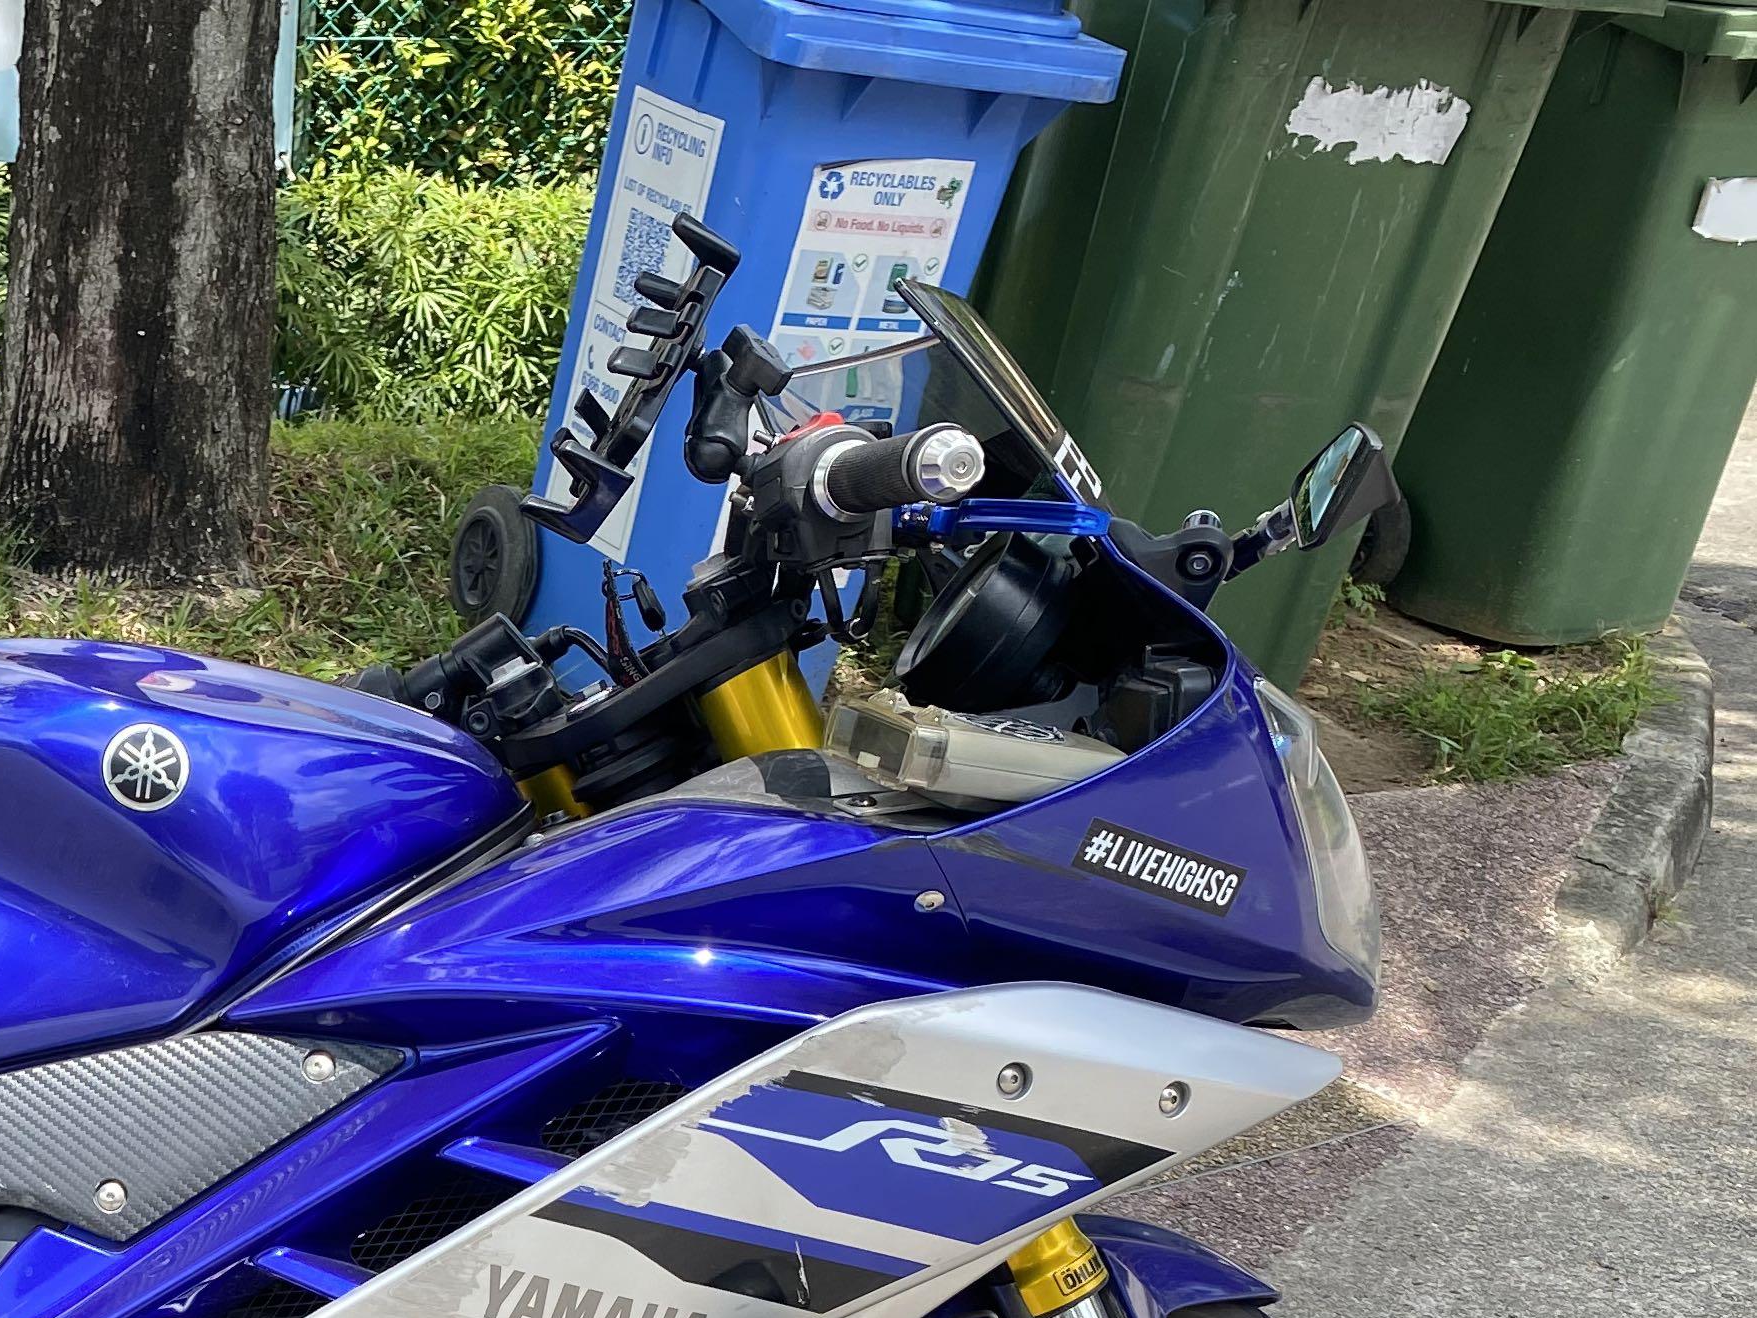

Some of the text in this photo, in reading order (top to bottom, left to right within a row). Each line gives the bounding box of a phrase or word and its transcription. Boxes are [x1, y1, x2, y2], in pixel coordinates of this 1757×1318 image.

[656, 122, 706, 157] RECYCLING
[652, 142, 673, 165] INFO
[850, 171, 937, 191] RECYCLABLES
[874, 191, 906, 207] ONLY
[835, 217, 848, 229] No
[878, 220, 890, 231] No
[1084, 829, 1239, 906] #LIVEHIGHSG
